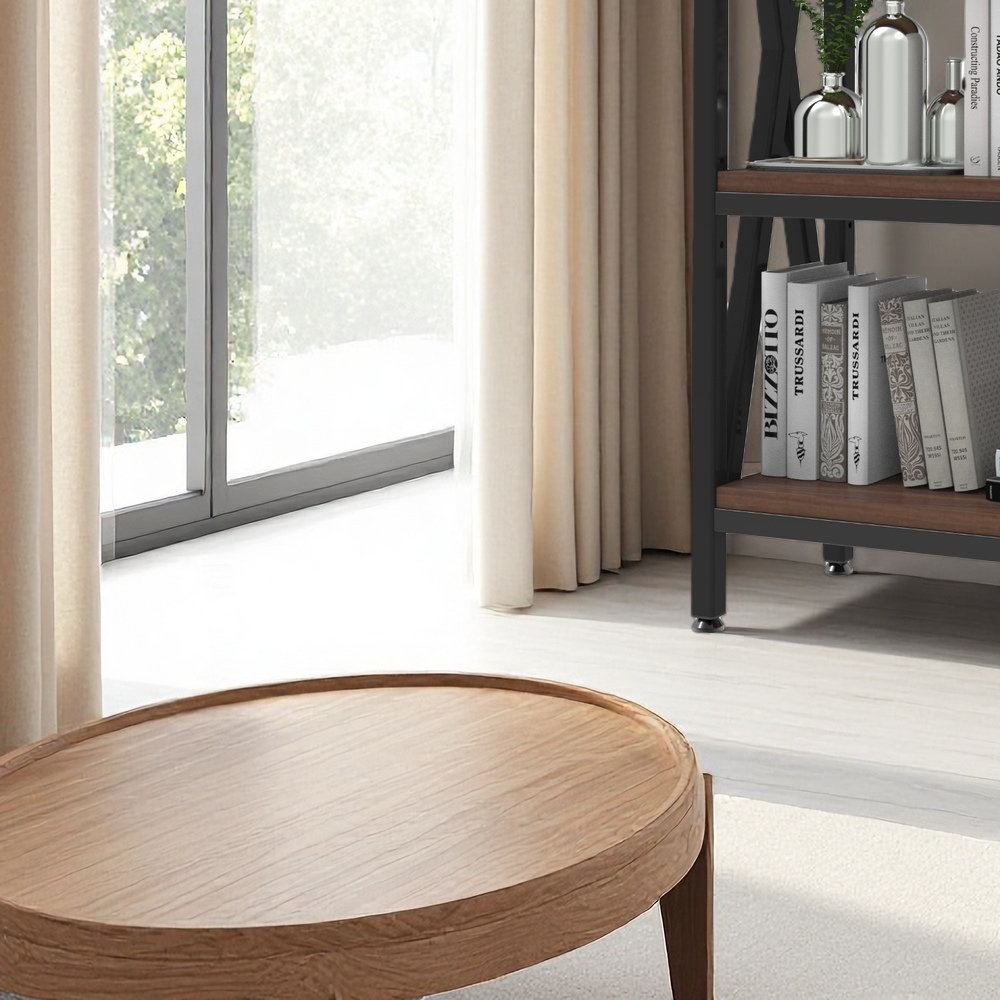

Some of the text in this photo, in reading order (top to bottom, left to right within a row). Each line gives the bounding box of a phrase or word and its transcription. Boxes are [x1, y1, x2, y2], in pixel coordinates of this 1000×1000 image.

[968, 26, 981, 110] Constructing Paradies
[795, 309, 804, 396] TRUSSARDI
[852, 312, 860, 401] TRUSSARDI
